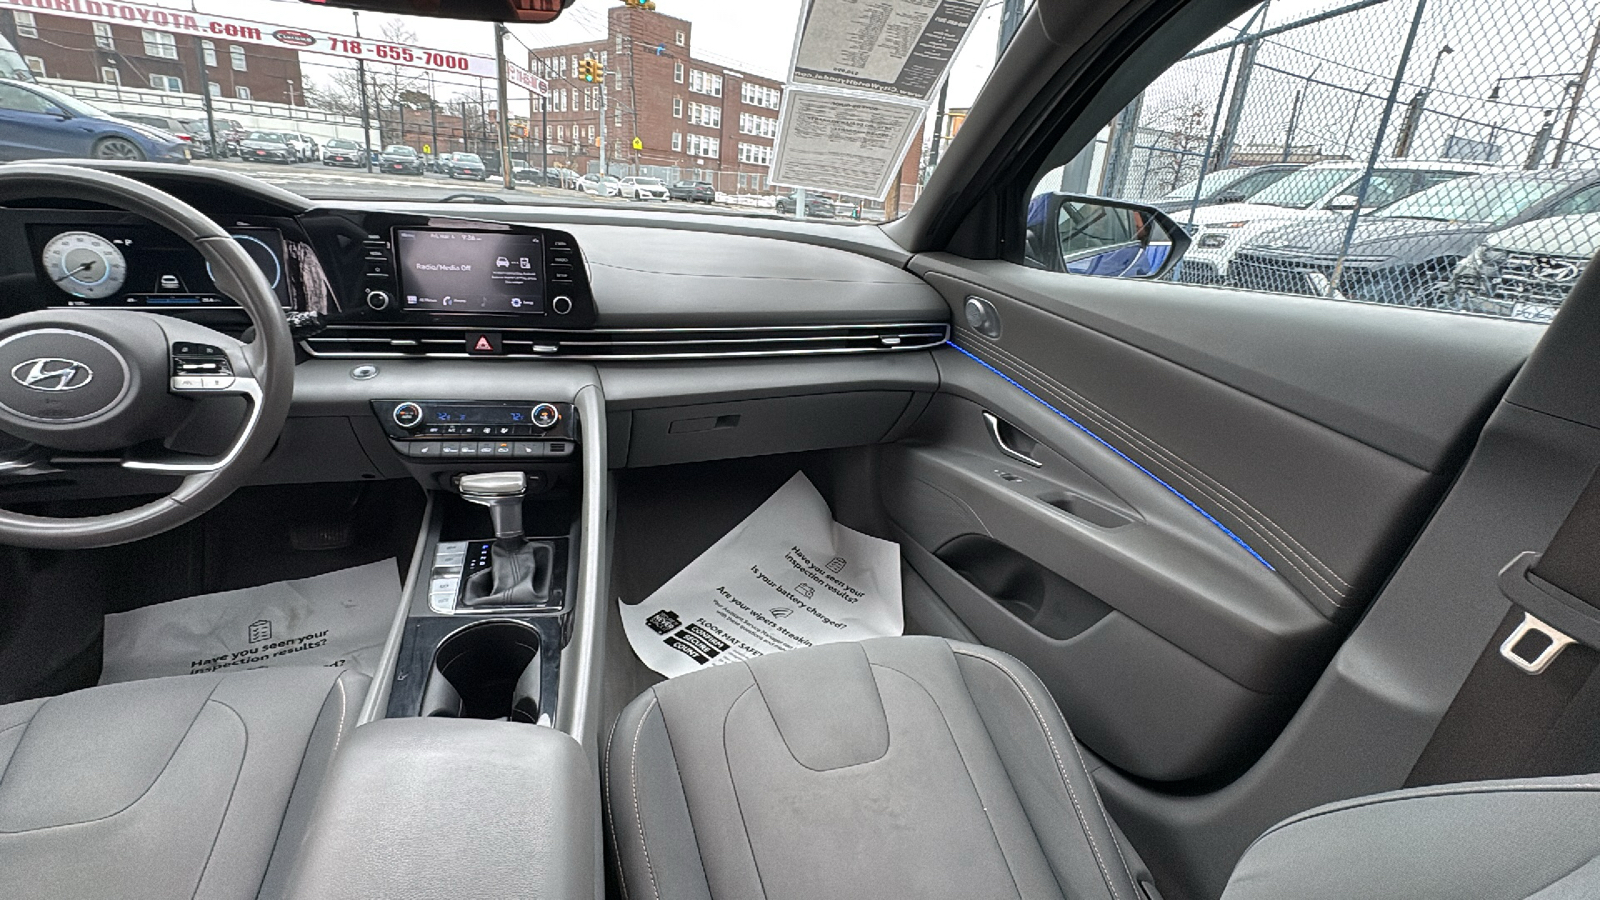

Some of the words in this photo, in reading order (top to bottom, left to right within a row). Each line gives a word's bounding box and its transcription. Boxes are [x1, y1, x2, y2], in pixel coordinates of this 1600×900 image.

[785, 552, 825, 585] inspection
[825, 583, 858, 604] results?
[791, 545, 811, 565] Have
[808, 563, 825, 576] you
[825, 574, 845, 587] seen
[843, 585, 865, 597] your
[716, 586, 732, 598] Are
[729, 597, 750, 611] your
[750, 610, 777, 627] wipers
[756, 572, 777, 588] your
[776, 585, 806, 608] battery
[806, 606, 847, 630] charged?
[682, 634, 711, 652] SECURE
[691, 626, 724, 648] CONFIRM
[696, 617, 723, 635] FLOOR
[721, 633, 740, 645] MAT
[191, 653, 229, 668] Have
[231, 647, 259, 660] you
[262, 638, 294, 652] seen
[296, 629, 329, 644] your
[272, 639, 328, 658] results?
[673, 642, 700, 658] COUNT
